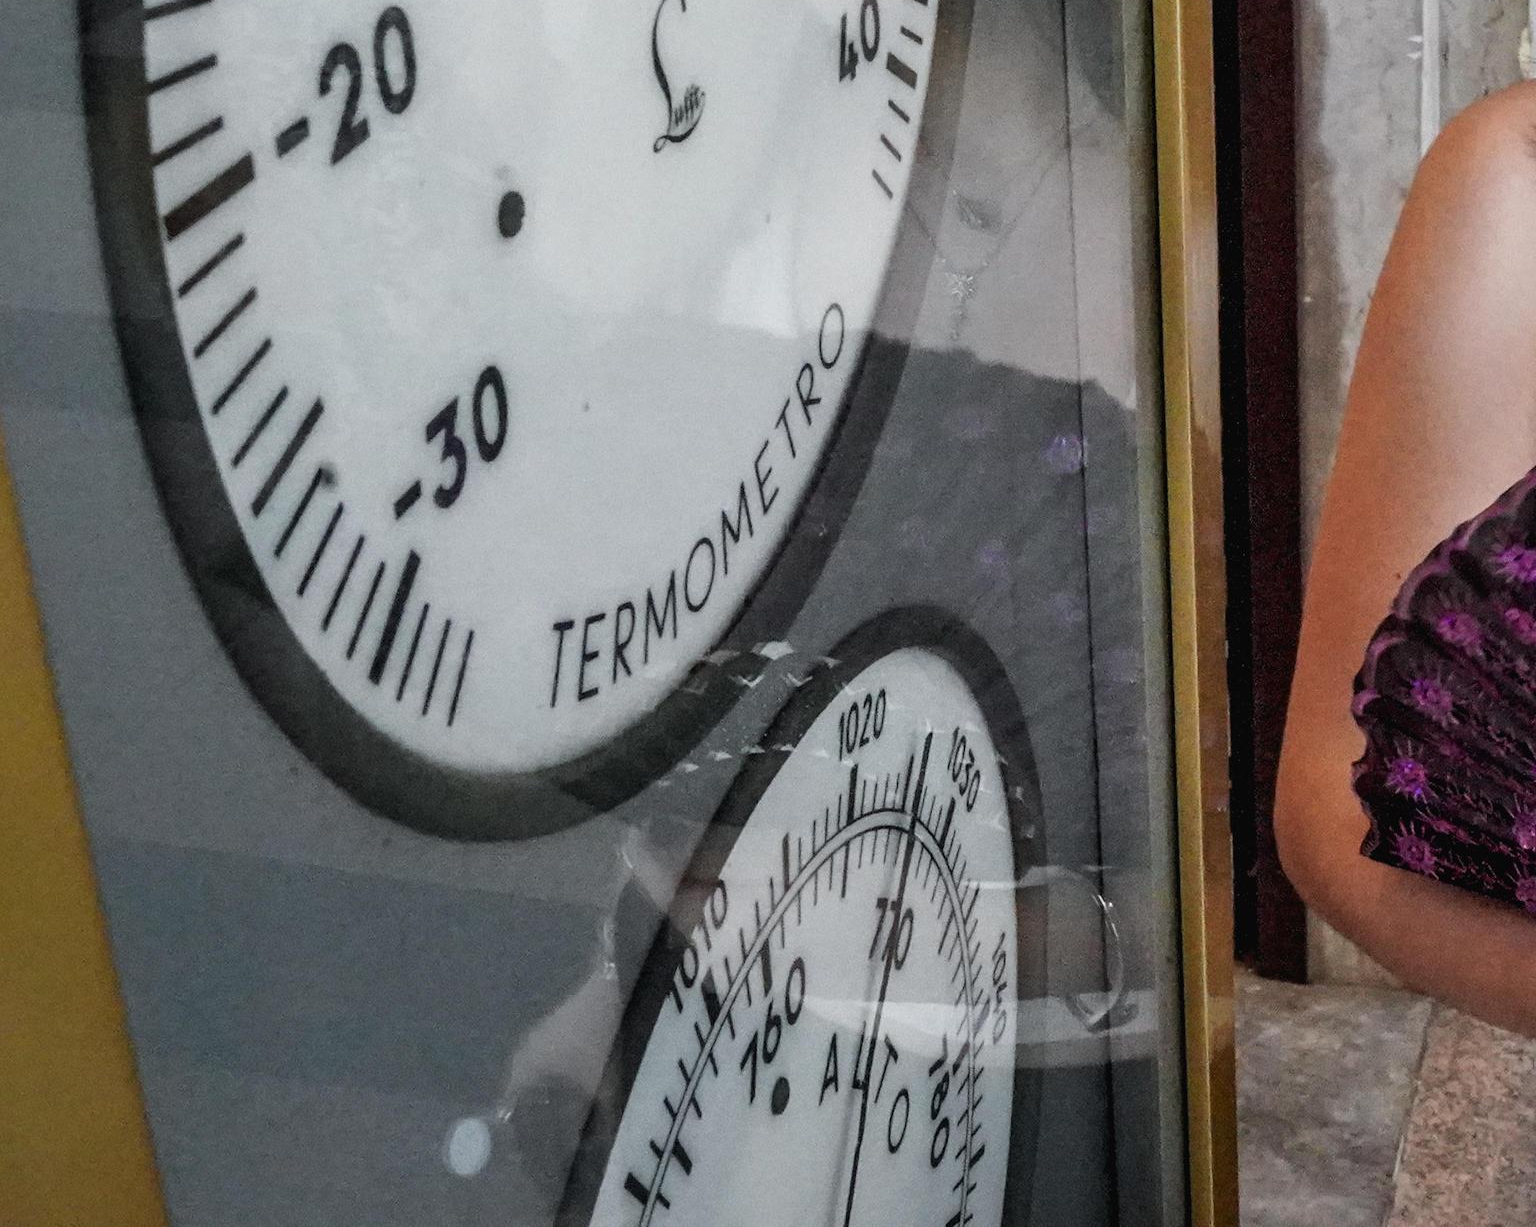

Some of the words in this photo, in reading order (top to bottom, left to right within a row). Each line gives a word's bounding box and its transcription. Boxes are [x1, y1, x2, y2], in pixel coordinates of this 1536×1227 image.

[275, 5, 417, 164] -20
[393, 365, 509, 521] -30
[549, 302, 845, 708] TERMOMETRO
[839, 688, 886, 762] 1020
[948, 726, 980, 813] 1030
[670, 878, 727, 1014] 1010
[867, 896, 914, 971] 770
[740, 956, 806, 1106] 760
[927, 1031, 950, 1168] 780
